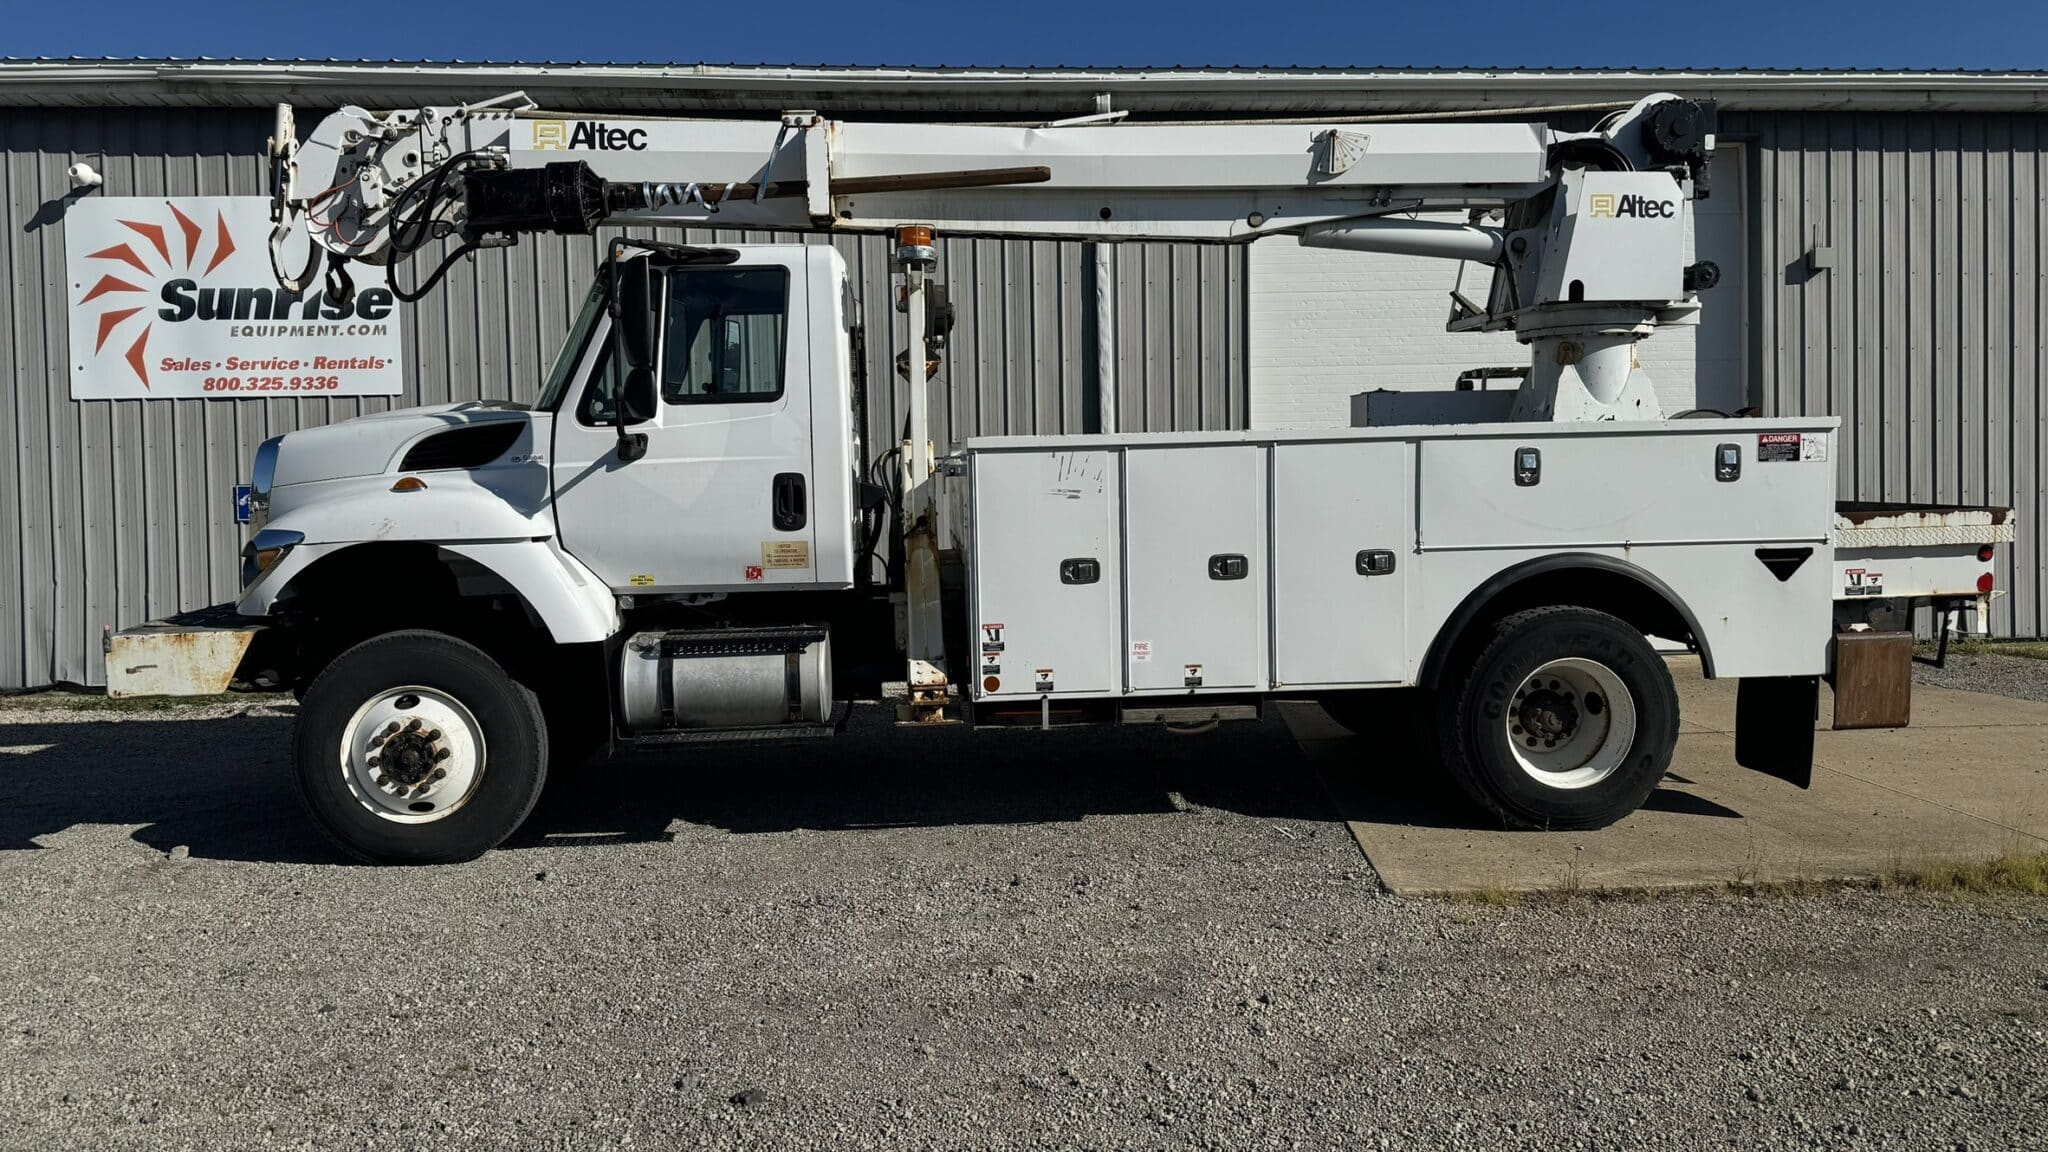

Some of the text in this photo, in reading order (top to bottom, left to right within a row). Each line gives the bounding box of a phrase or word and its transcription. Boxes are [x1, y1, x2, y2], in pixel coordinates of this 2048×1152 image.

[567, 121, 648, 151] Altec
[1615, 194, 1675, 219] Altec
[158, 278, 393, 322] Sunrise
[230, 324, 388, 338] EQUIPMENT.COM
[160, 356, 385, 371] Sales Service Rentals
[203, 376, 339, 392] 800.325.9336
[1768, 434, 1798, 443] DANGER
